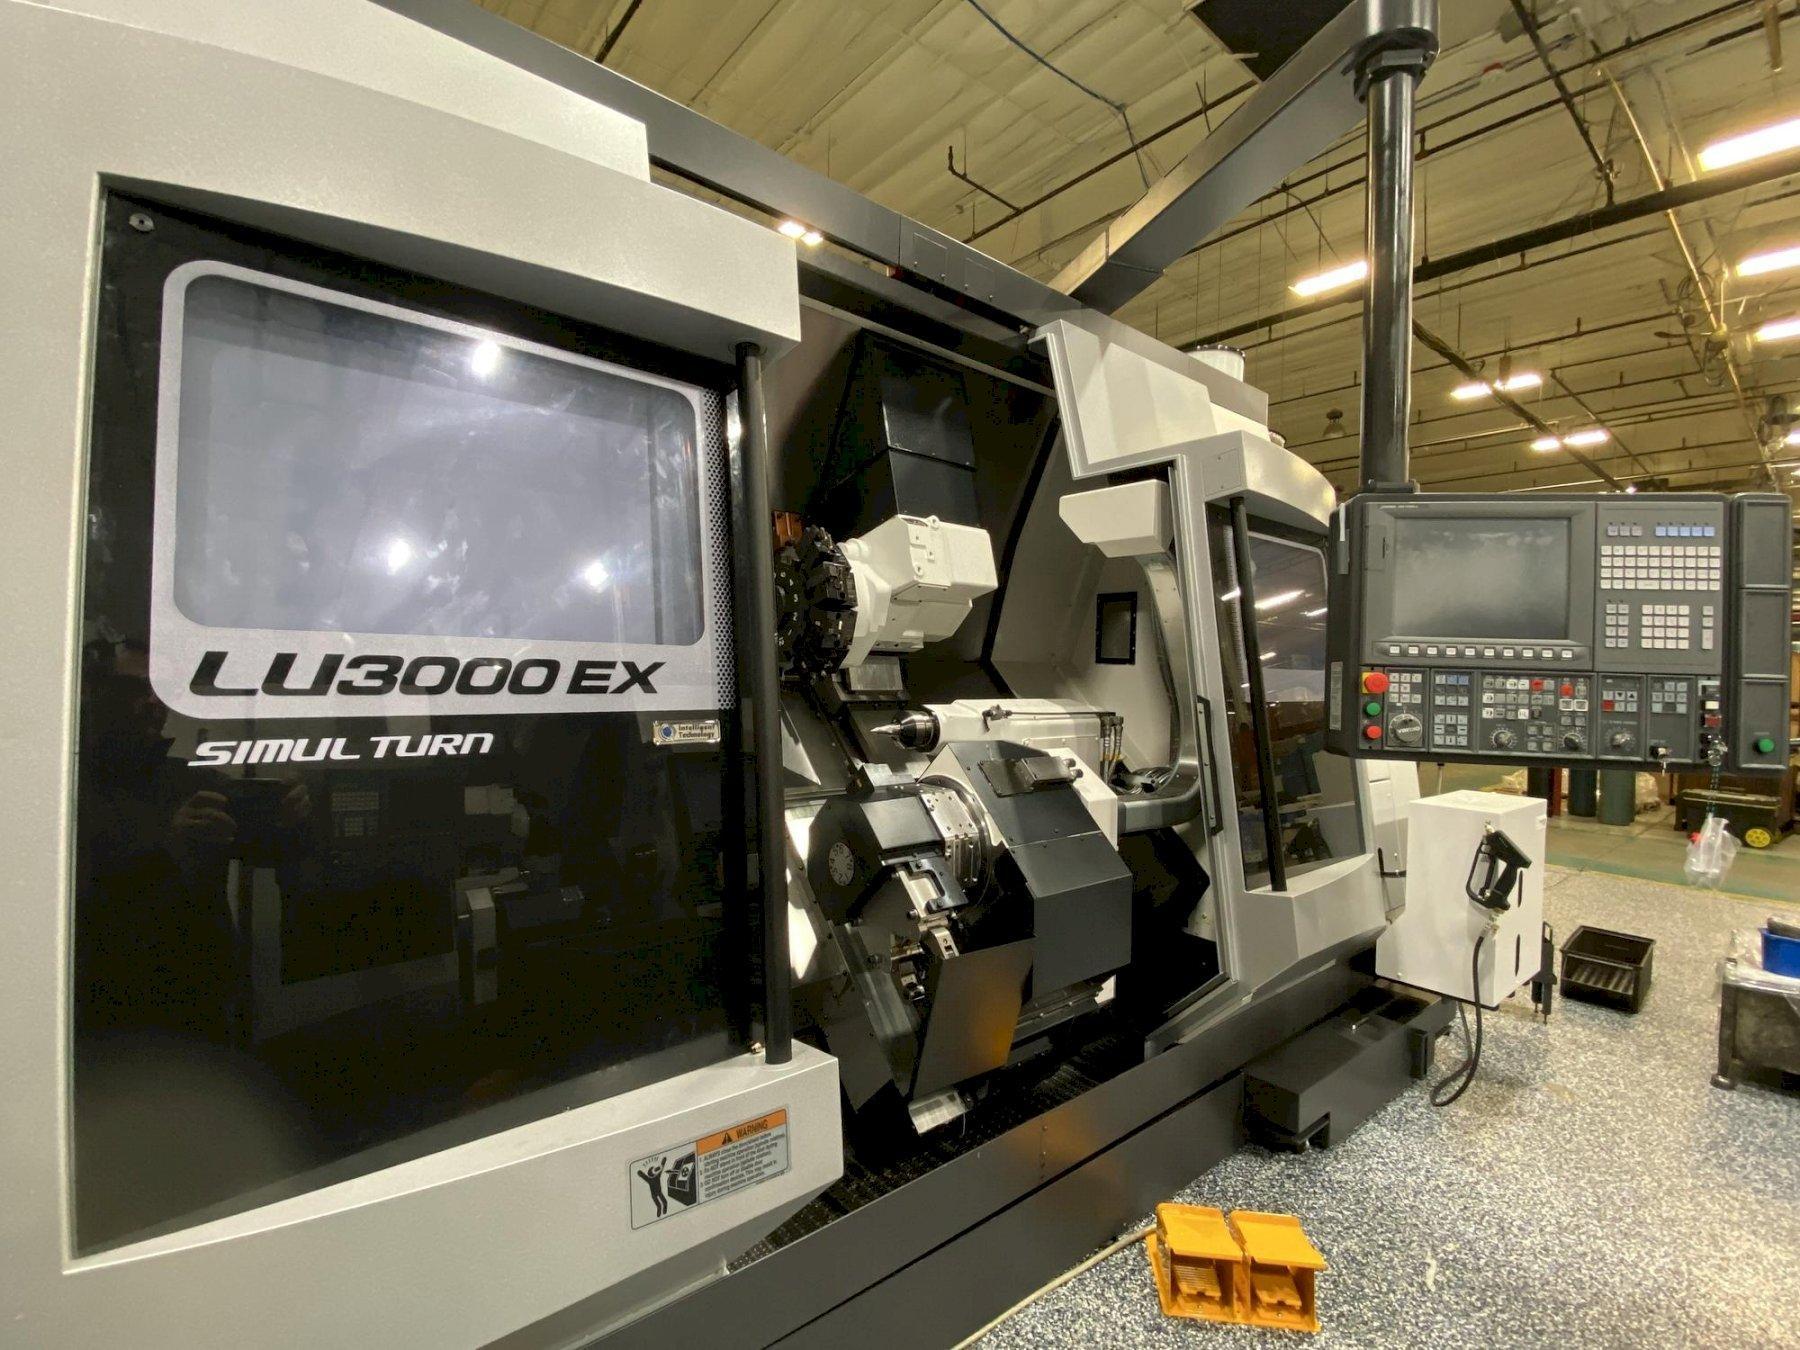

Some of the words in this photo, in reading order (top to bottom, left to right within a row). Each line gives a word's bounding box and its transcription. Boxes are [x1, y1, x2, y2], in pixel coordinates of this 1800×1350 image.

[189, 651, 560, 696] LU3000
[566, 660, 667, 694] EX
[678, 723, 715, 732] Intelligent
[678, 731, 715, 740] Technology
[187, 737, 360, 766] SIMUL
[369, 733, 494, 759] TURN
[736, 1119, 768, 1139] WARNING
